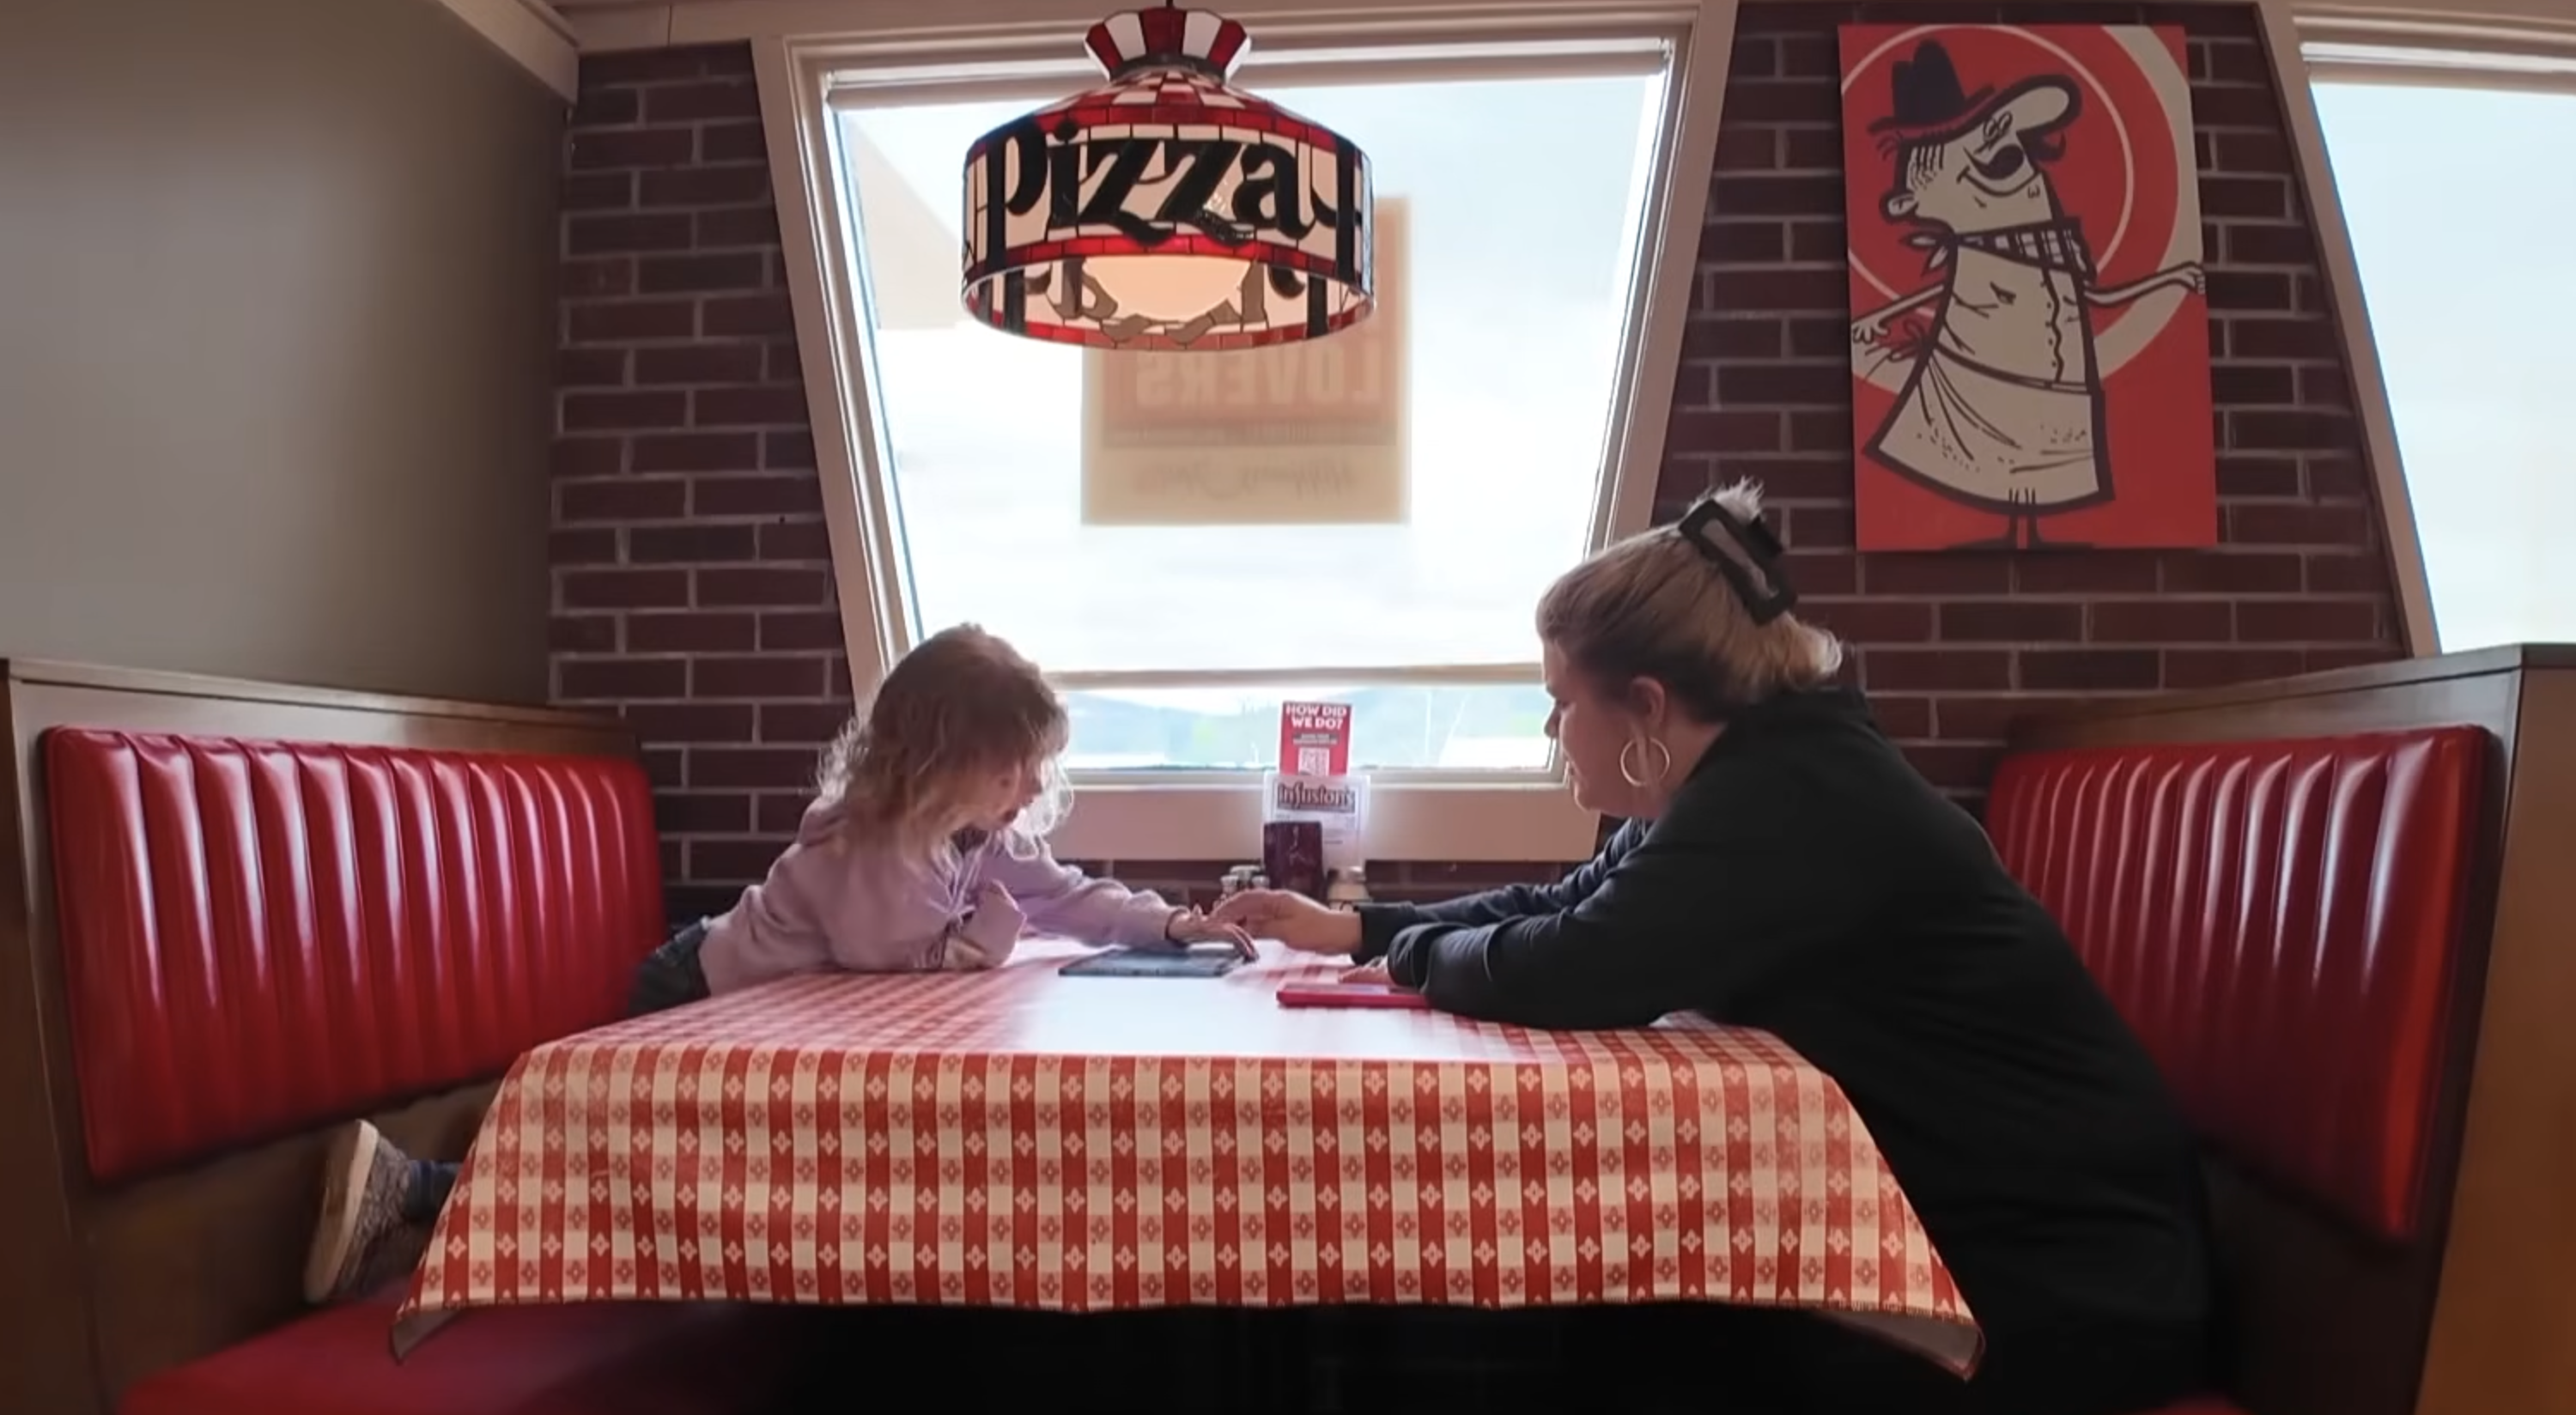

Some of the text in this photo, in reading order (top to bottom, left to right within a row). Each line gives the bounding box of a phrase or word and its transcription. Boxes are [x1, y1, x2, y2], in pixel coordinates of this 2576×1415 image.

[986, 118, 1315, 270] Pizza
[1285, 704, 1347, 718] HOW DID
[1291, 716, 1343, 730] WE DO?
